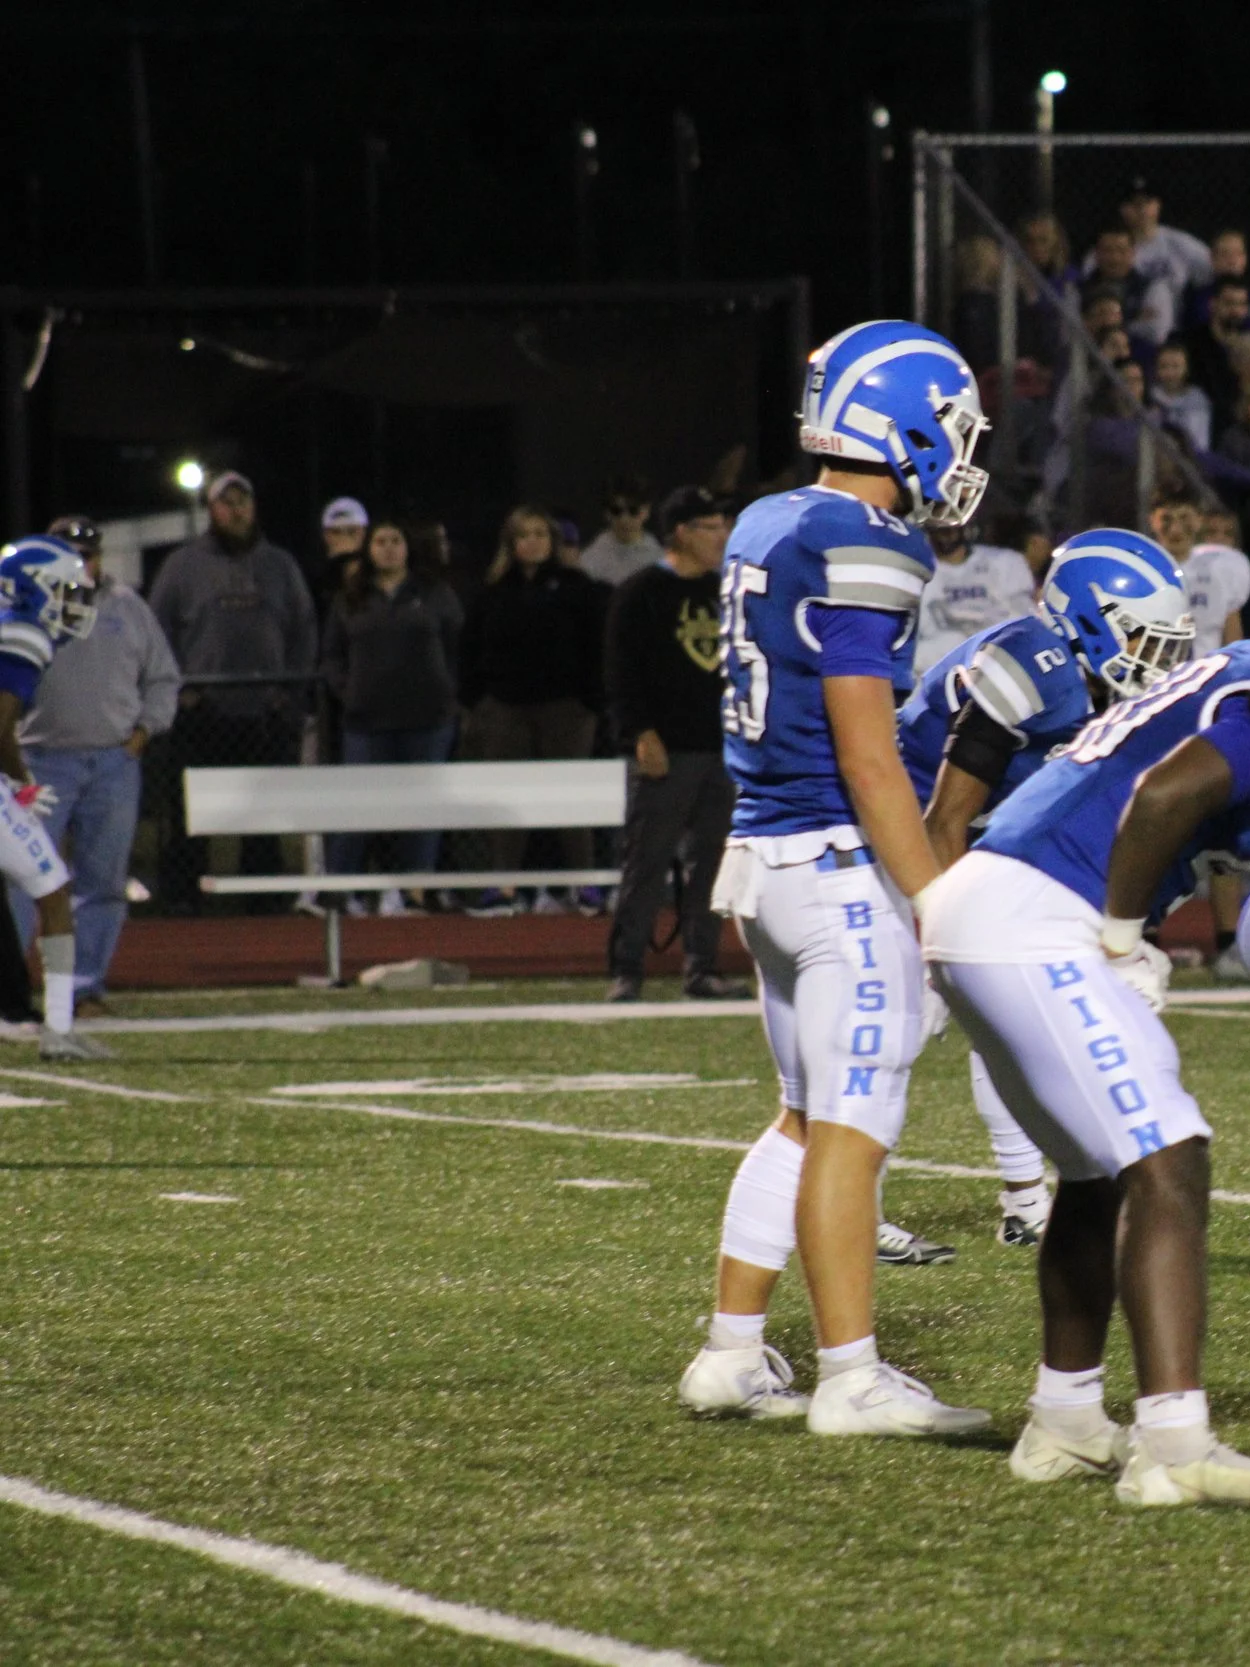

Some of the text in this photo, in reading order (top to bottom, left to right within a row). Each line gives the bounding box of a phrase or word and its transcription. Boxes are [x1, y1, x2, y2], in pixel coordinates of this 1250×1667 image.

[1033, 646, 1068, 674] 2
[0, 794, 52, 874] ISON
[842, 900, 887, 1097] BISON
[1044, 960, 1167, 1158] BISON
